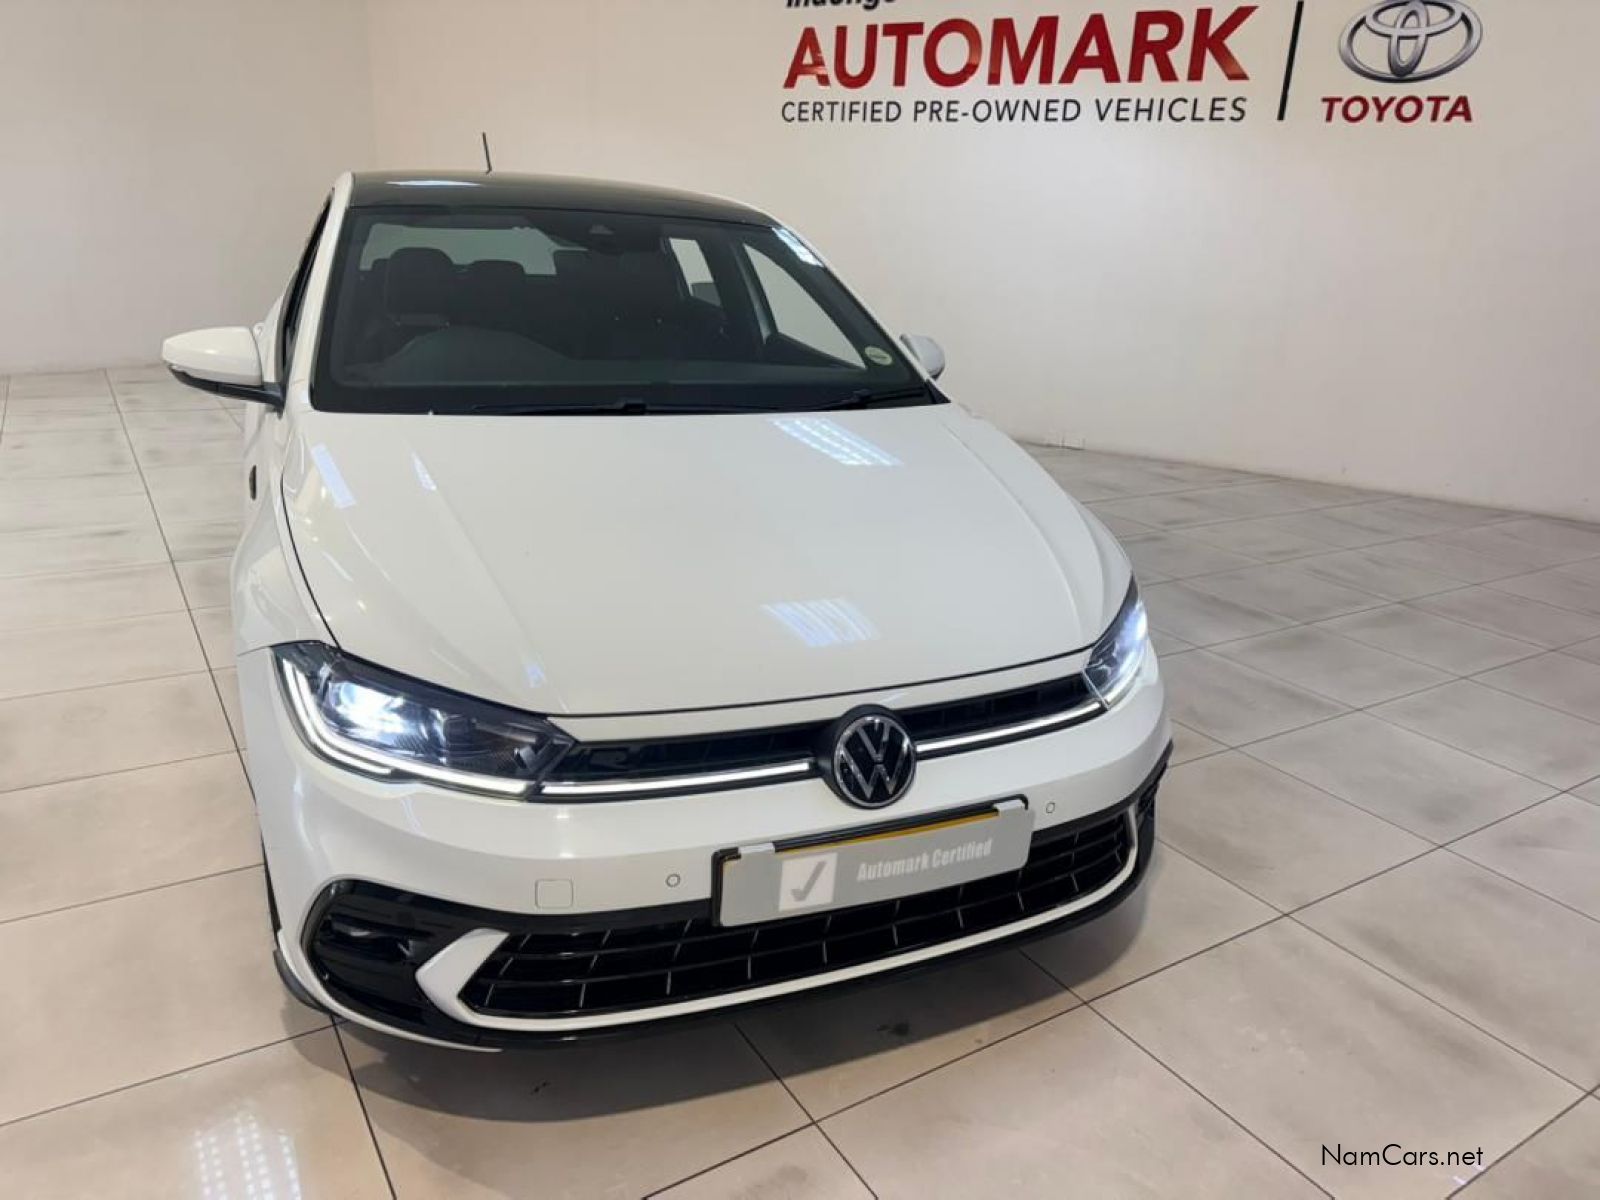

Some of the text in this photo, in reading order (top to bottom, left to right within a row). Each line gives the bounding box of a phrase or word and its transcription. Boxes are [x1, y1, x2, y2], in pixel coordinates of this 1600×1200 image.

[782, 5, 1260, 90] AUTOMARK
[781, 97, 1247, 123] CERTIFIED PRE-OWNED VEHICLES
[1321, 95, 1473, 123] TOYOTA
[857, 838, 993, 882] Automark Certified
